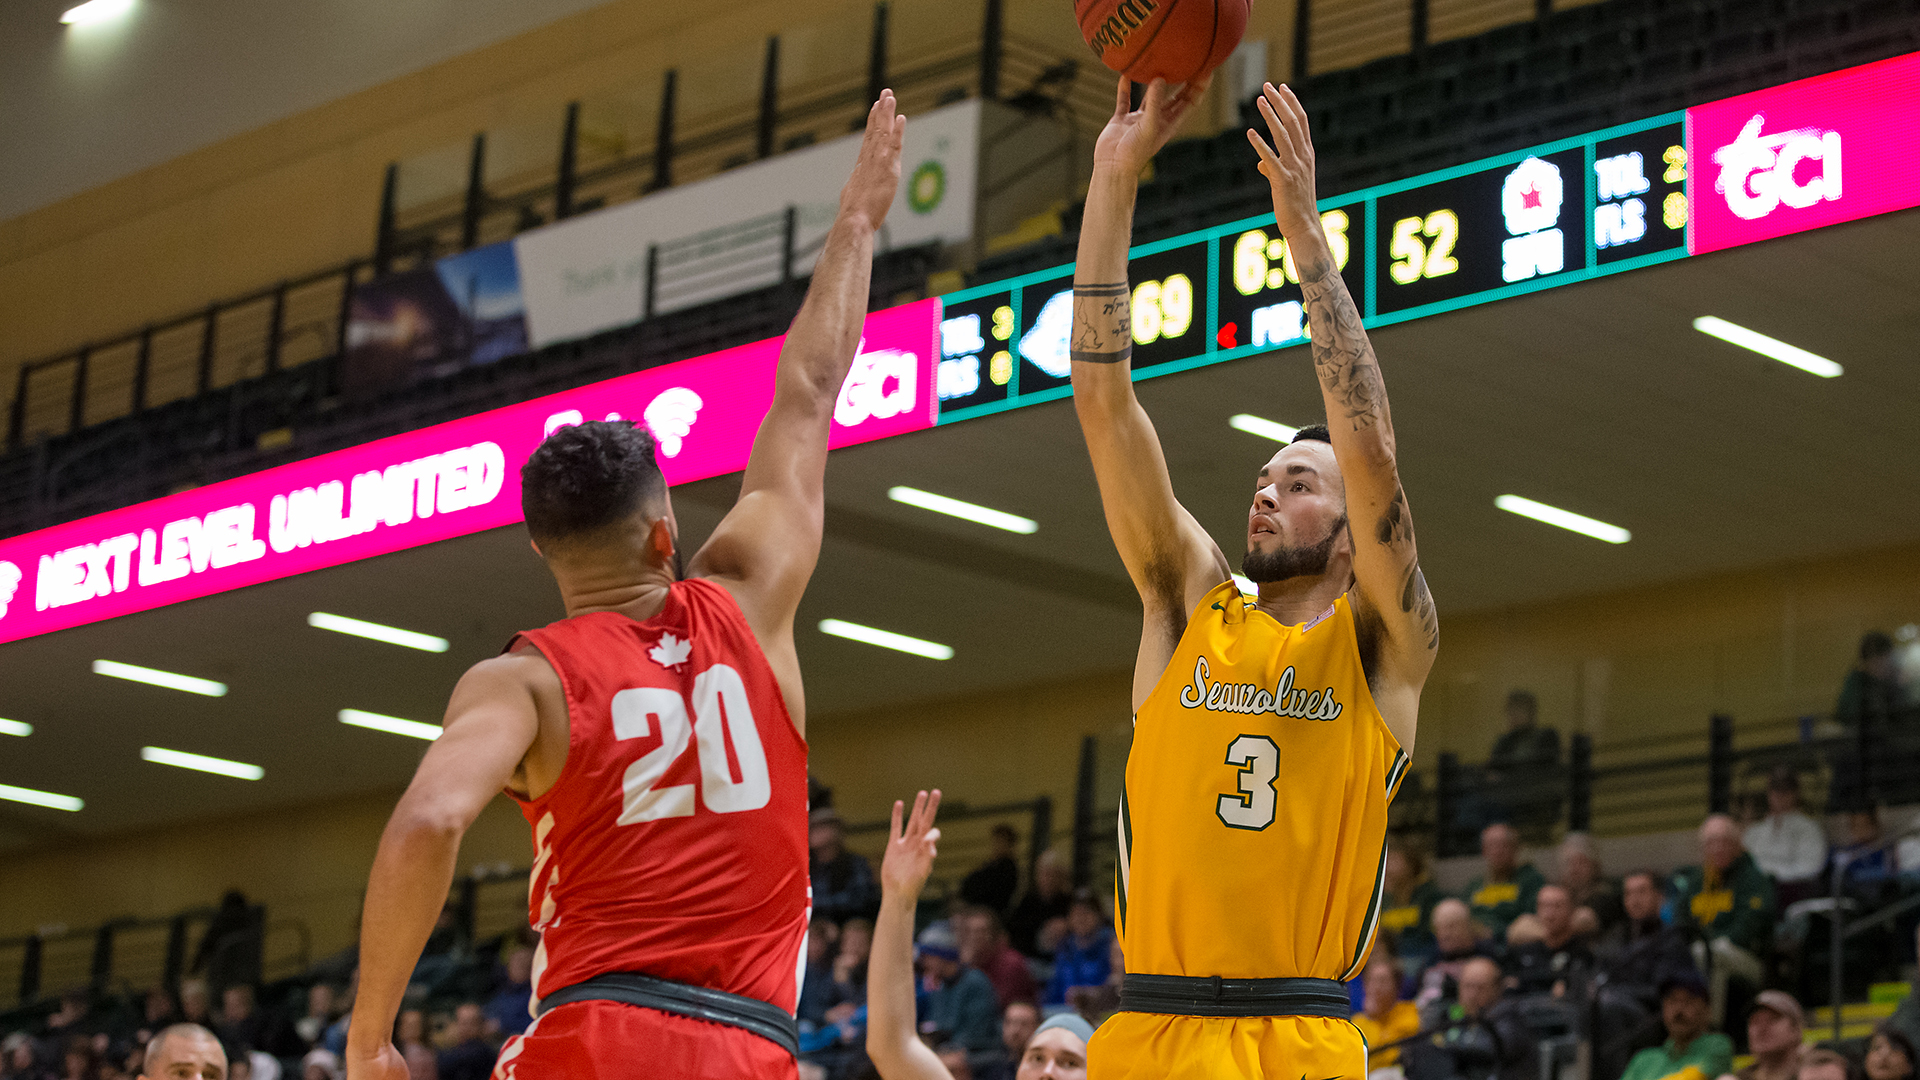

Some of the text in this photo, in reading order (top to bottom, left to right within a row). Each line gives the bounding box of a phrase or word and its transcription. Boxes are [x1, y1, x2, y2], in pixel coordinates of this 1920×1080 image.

[1090, 0, 1160, 58] Wilso
[1663, 145, 1688, 184] 2
[1712, 113, 1842, 220] GCI
[1390, 209, 1458, 285] 52
[991, 305, 1015, 341] 3
[1131, 273, 1193, 346] 69
[35, 441, 505, 612] NEXT LEVEL UNLIMITED
[1180, 655, 1343, 721] Seawolves
[611, 663, 771, 827] 20
[1215, 733, 1281, 832] 3
